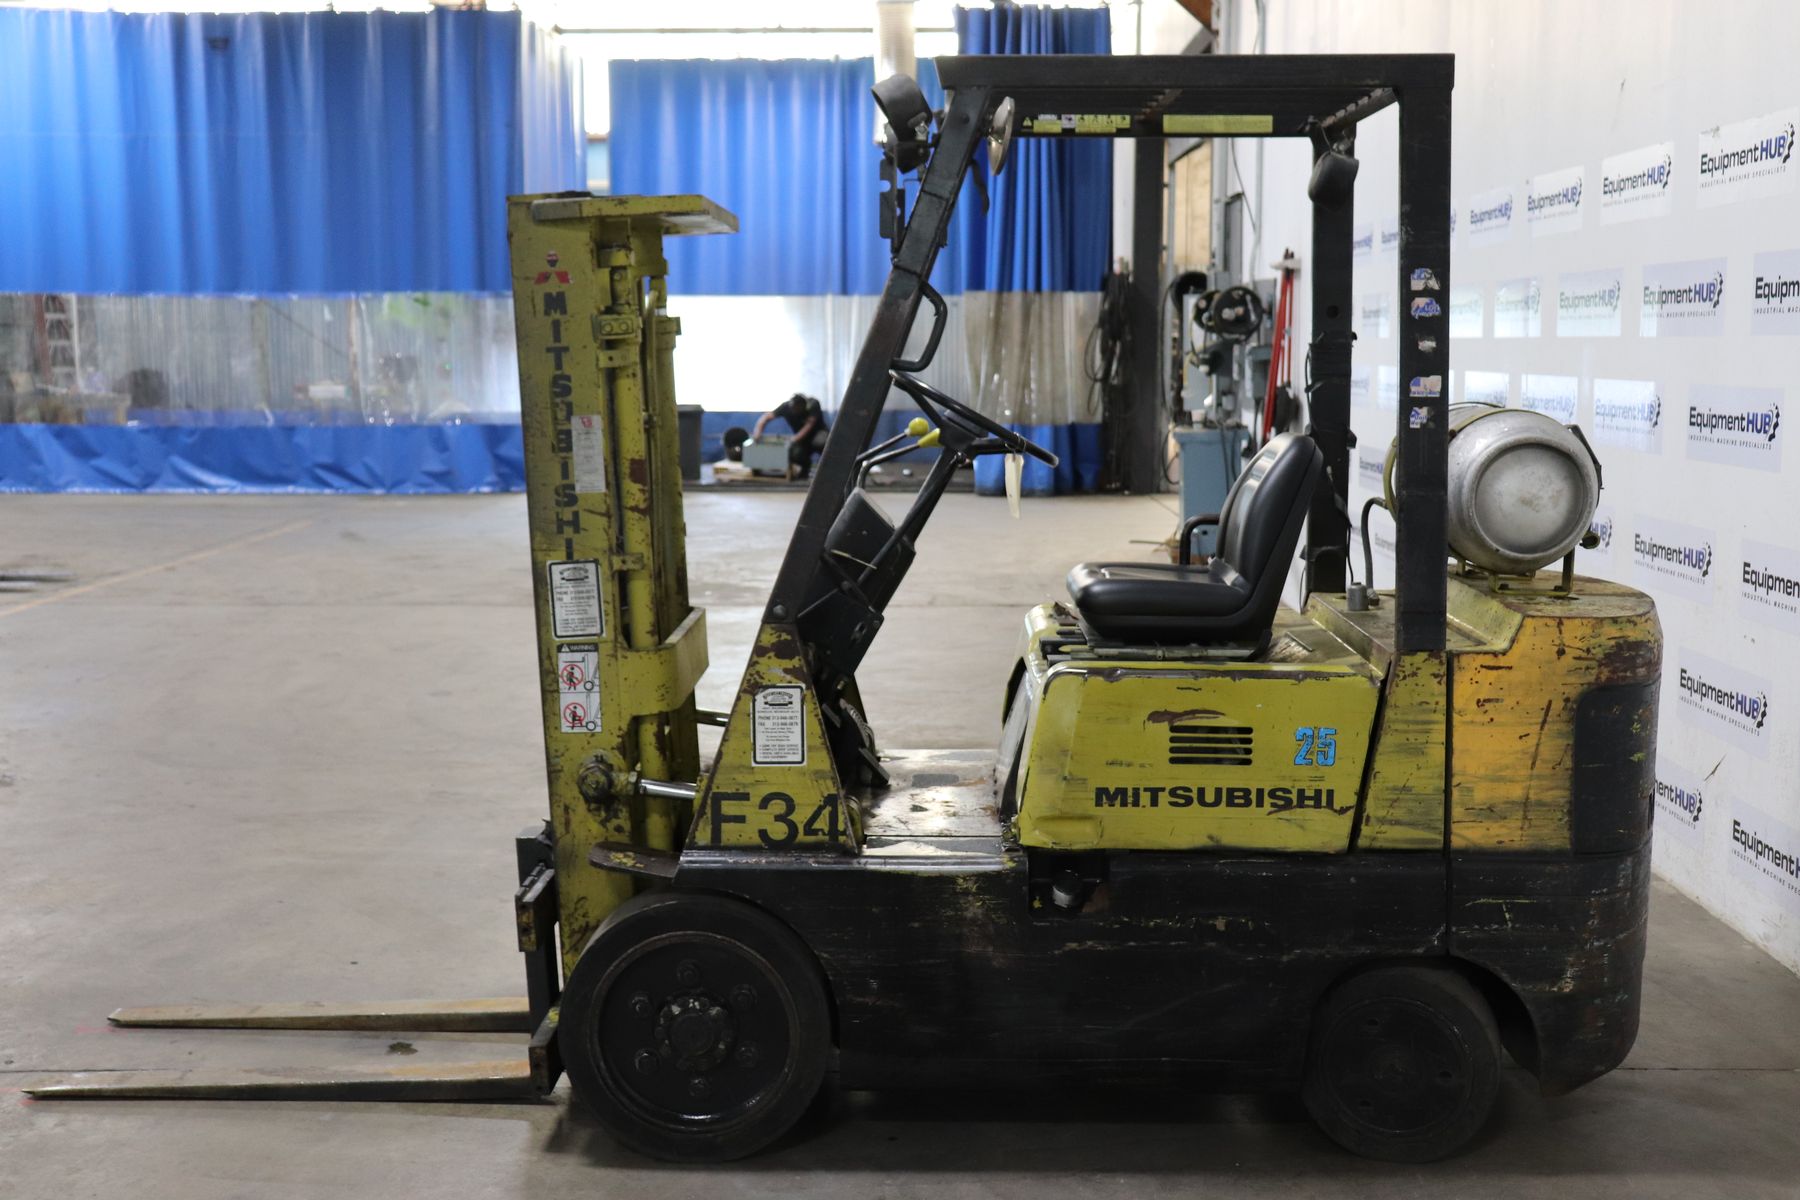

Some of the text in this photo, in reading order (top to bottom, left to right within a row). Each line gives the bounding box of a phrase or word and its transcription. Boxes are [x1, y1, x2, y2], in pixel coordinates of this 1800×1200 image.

[1700, 134, 1786, 178] EquipmentHUB
[1755, 275, 1800, 305] Equipm
[1689, 406, 1772, 434] EquipmentHUB
[1634, 533, 1706, 570] EquipmentHUB
[1743, 561, 1800, 599] Equipmen
[1680, 667, 1761, 720] EquipmentHUB
[1293, 727, 1338, 767] 25
[1095, 786, 1336, 810] MITSUBISHI
[710, 791, 847, 848] F34
